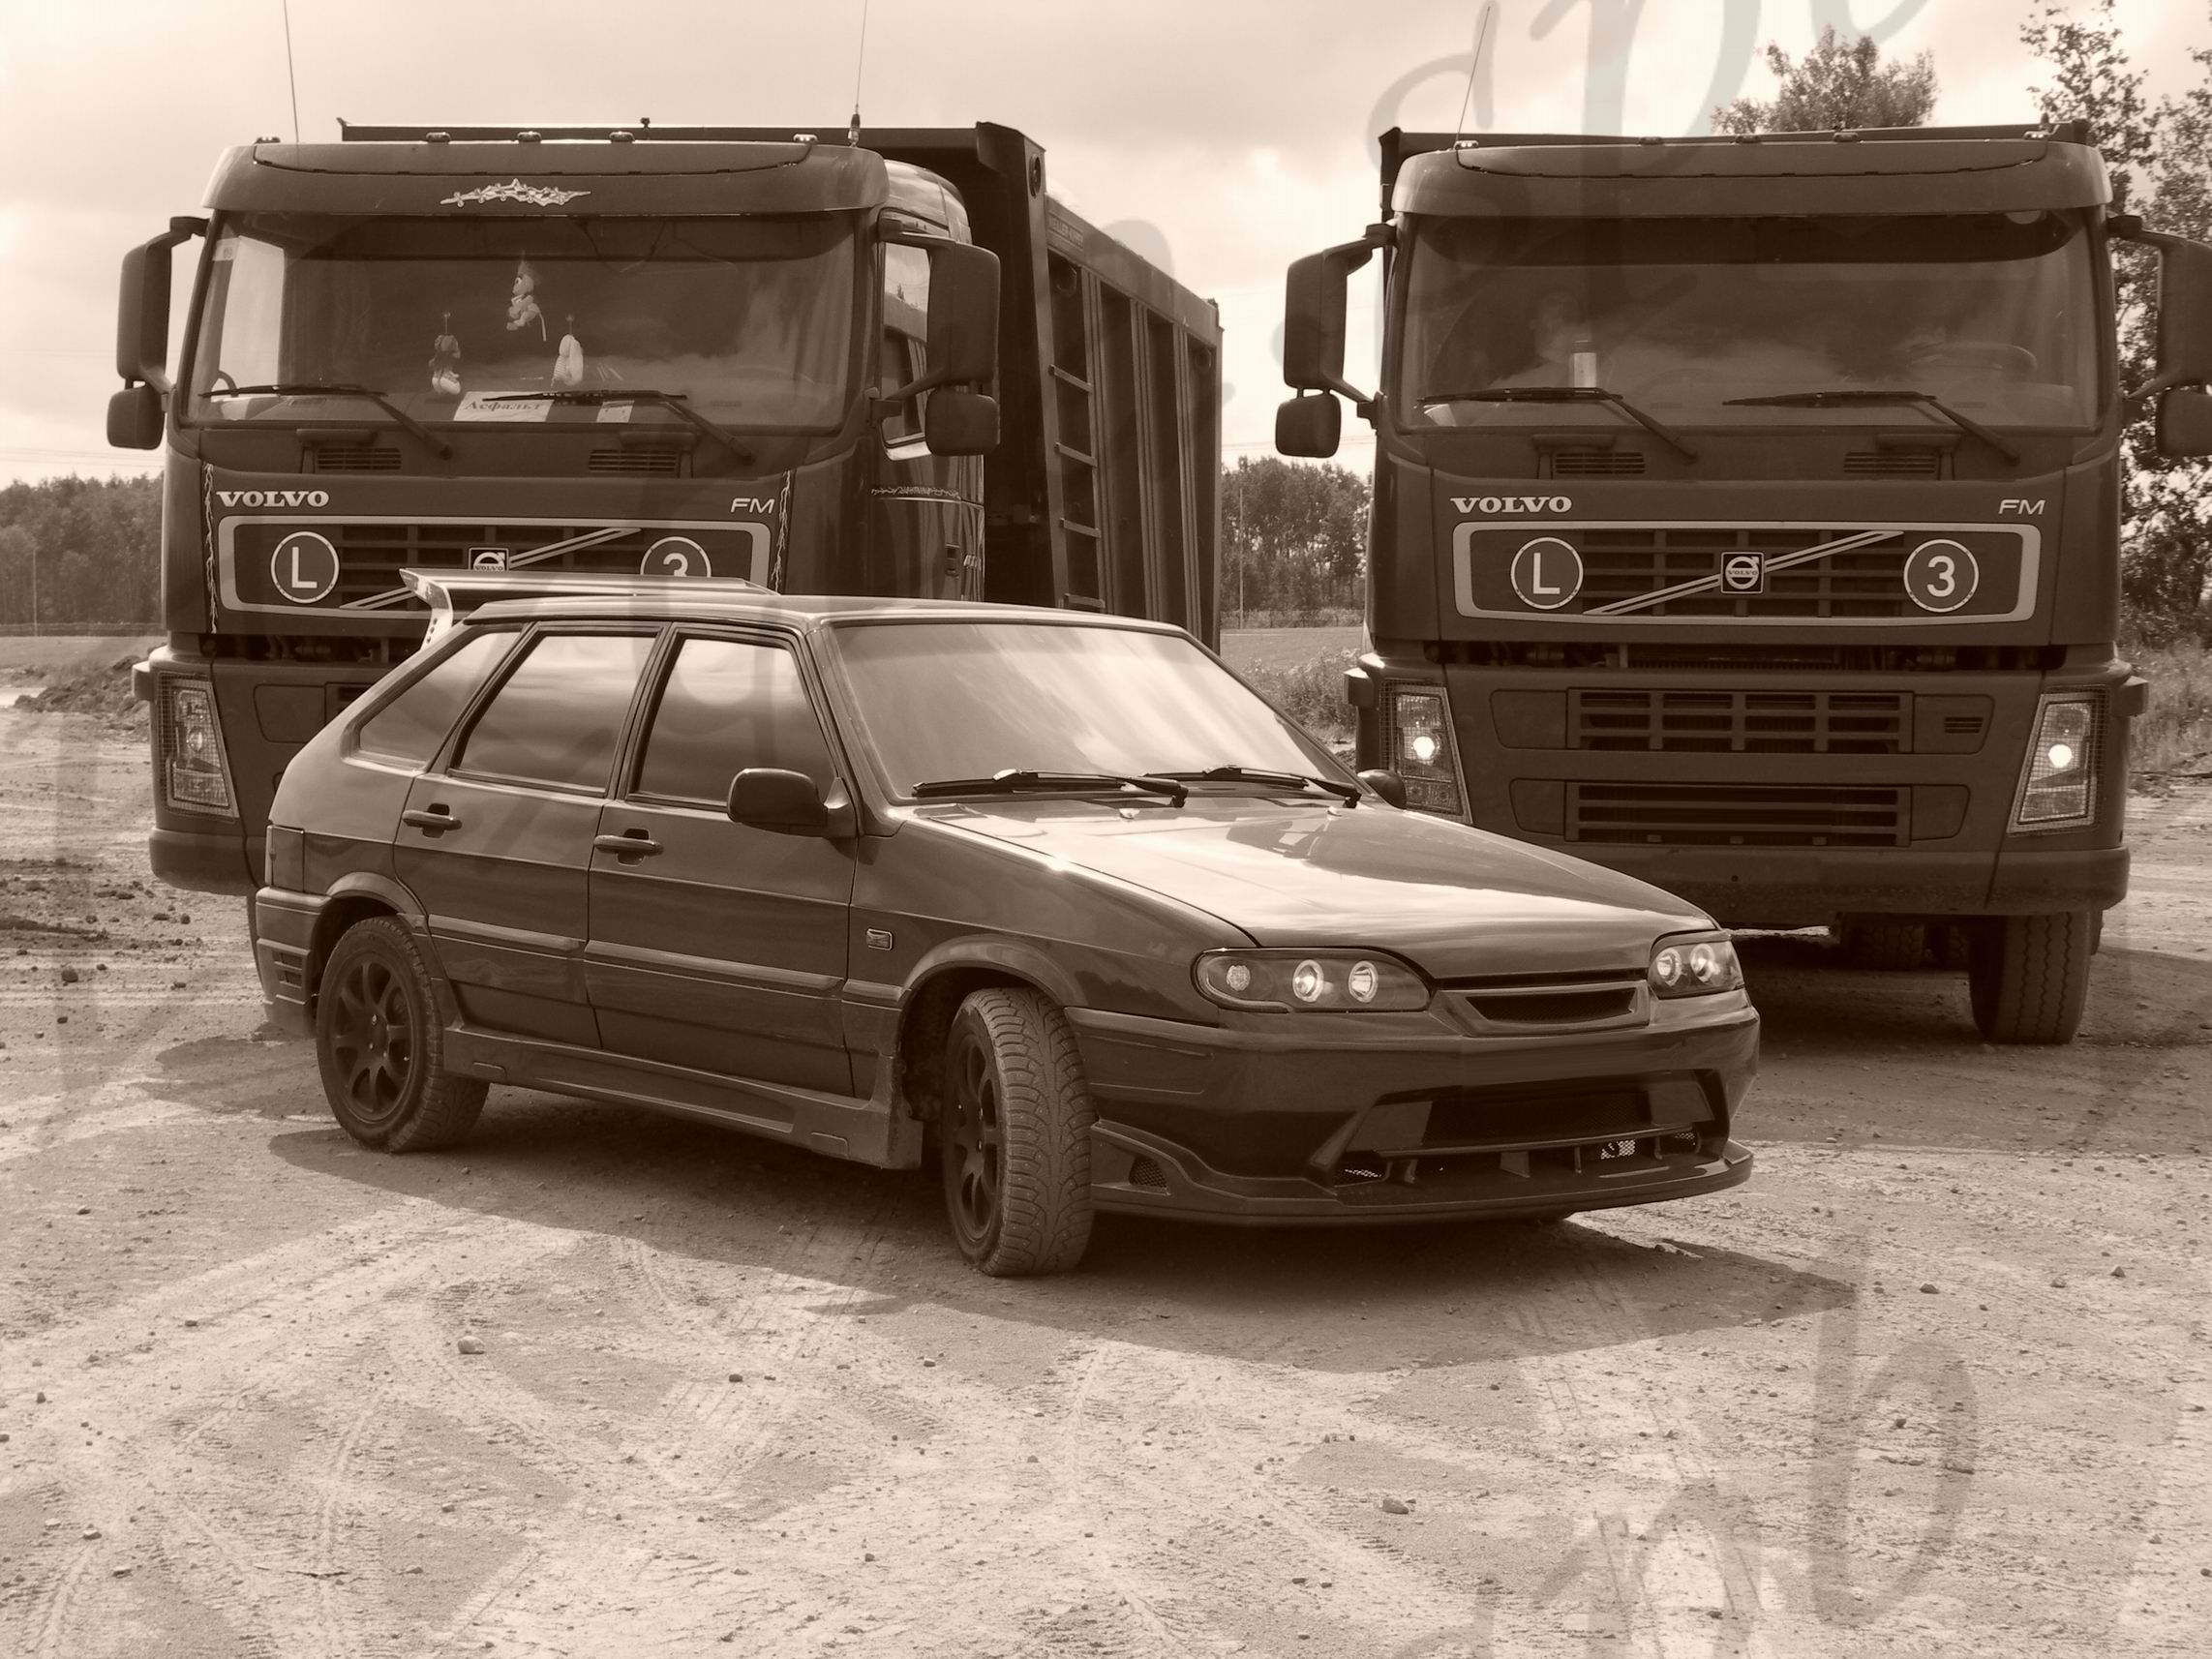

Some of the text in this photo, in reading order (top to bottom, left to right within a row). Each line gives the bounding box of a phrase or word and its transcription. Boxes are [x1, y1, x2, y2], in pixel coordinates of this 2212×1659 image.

[216, 491, 329, 507] VOLVO
[731, 498, 775, 514] FM
[1450, 496, 1572, 514] VOLVO
[1999, 498, 2046, 515] FM
[292, 547, 318, 588] L
[1532, 553, 1561, 594] L
[1926, 556, 1955, 597] 3
